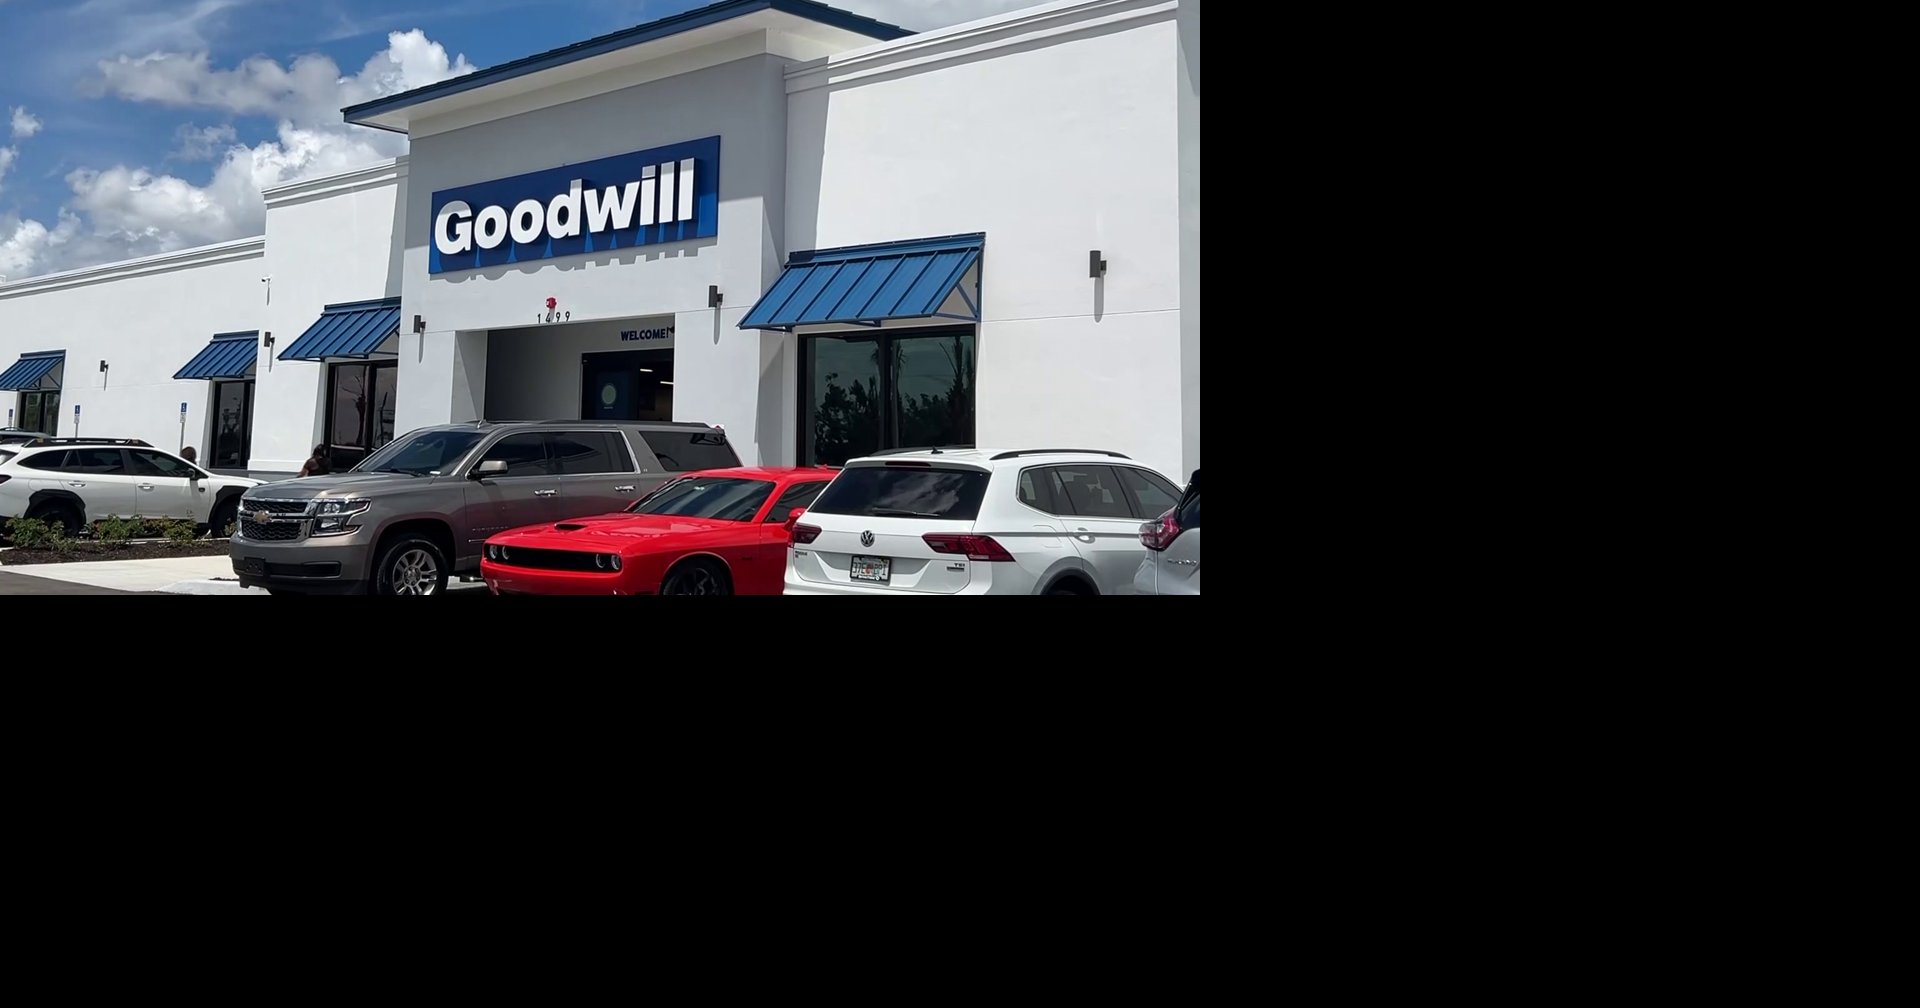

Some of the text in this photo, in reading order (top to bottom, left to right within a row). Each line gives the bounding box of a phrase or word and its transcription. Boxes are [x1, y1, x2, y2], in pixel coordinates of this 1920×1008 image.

[434, 157, 695, 255] Goodwill
[537, 311, 571, 324] 1499
[620, 326, 669, 342] WELCOME!
